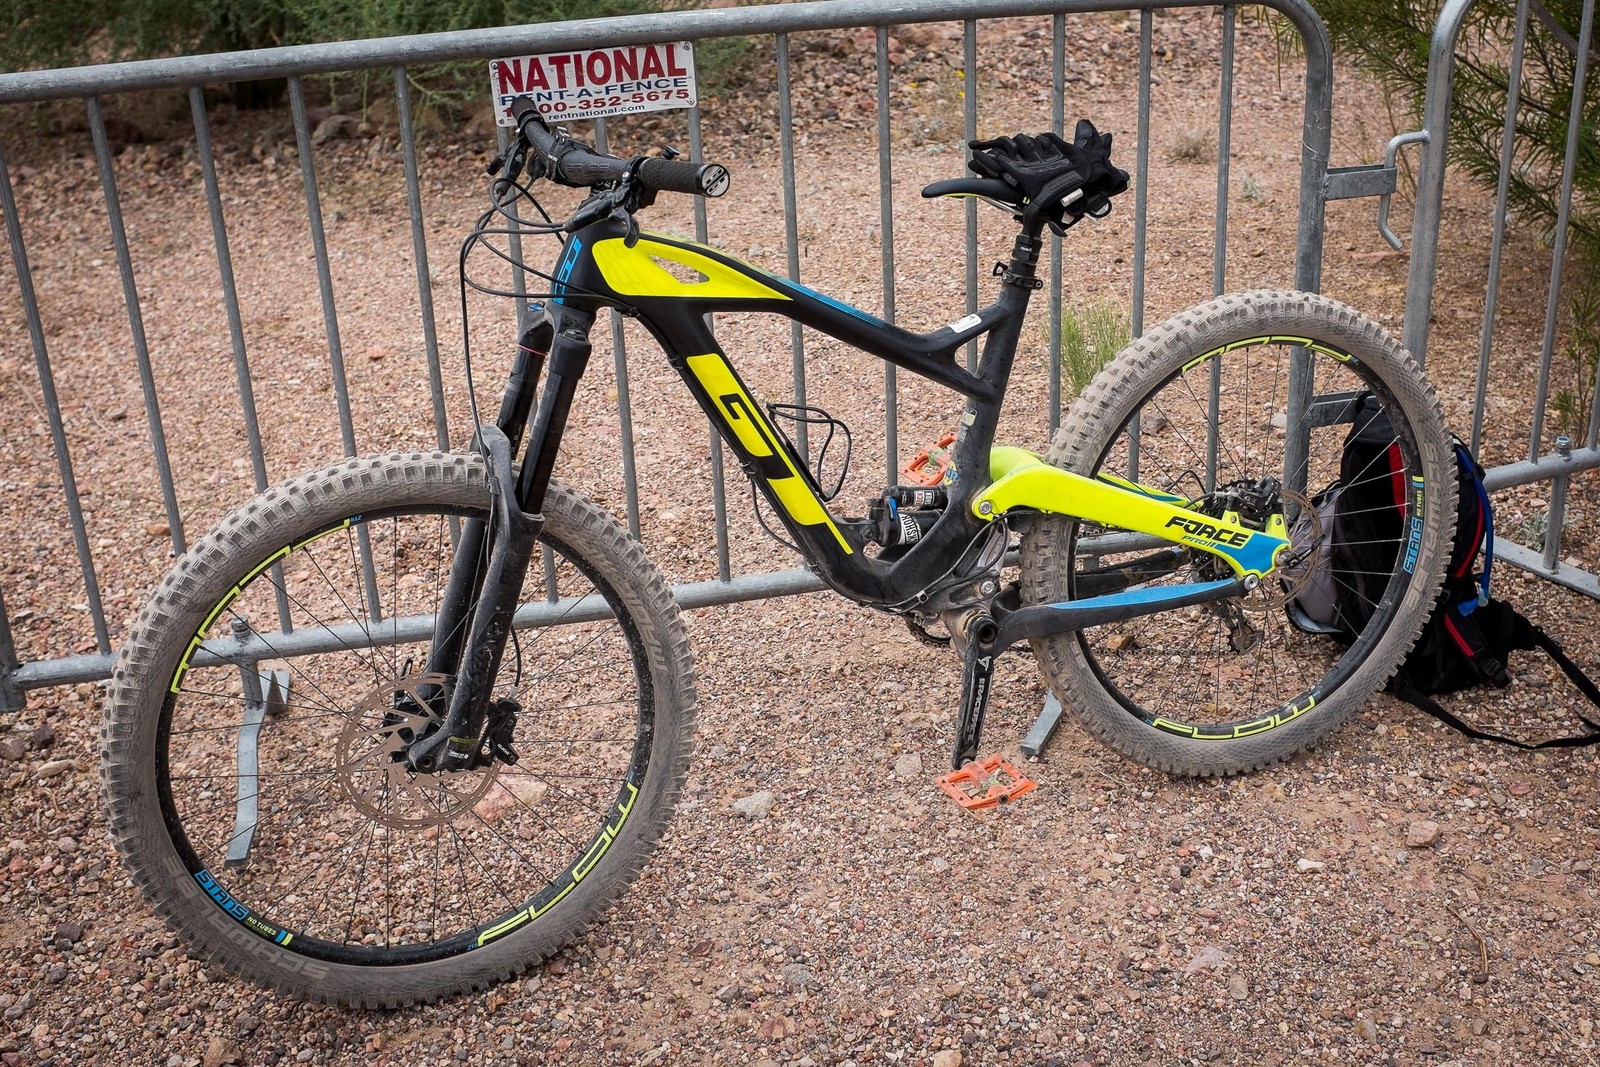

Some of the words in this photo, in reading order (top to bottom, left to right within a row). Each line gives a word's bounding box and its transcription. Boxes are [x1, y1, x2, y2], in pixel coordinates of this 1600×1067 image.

[498, 44, 687, 95] NATIONAL
[501, 78, 688, 106] RNT-A-FENCE
[503, 89, 689, 118] 100-352-5675
[548, 104, 645, 121] rentnational.com
[1165, 515, 1250, 547] FORCE
[1403, 517, 1423, 575] STANS
[194, 869, 250, 921] STANS
[247, 916, 257, 925] NO
[256, 922, 277, 936] TUBES
